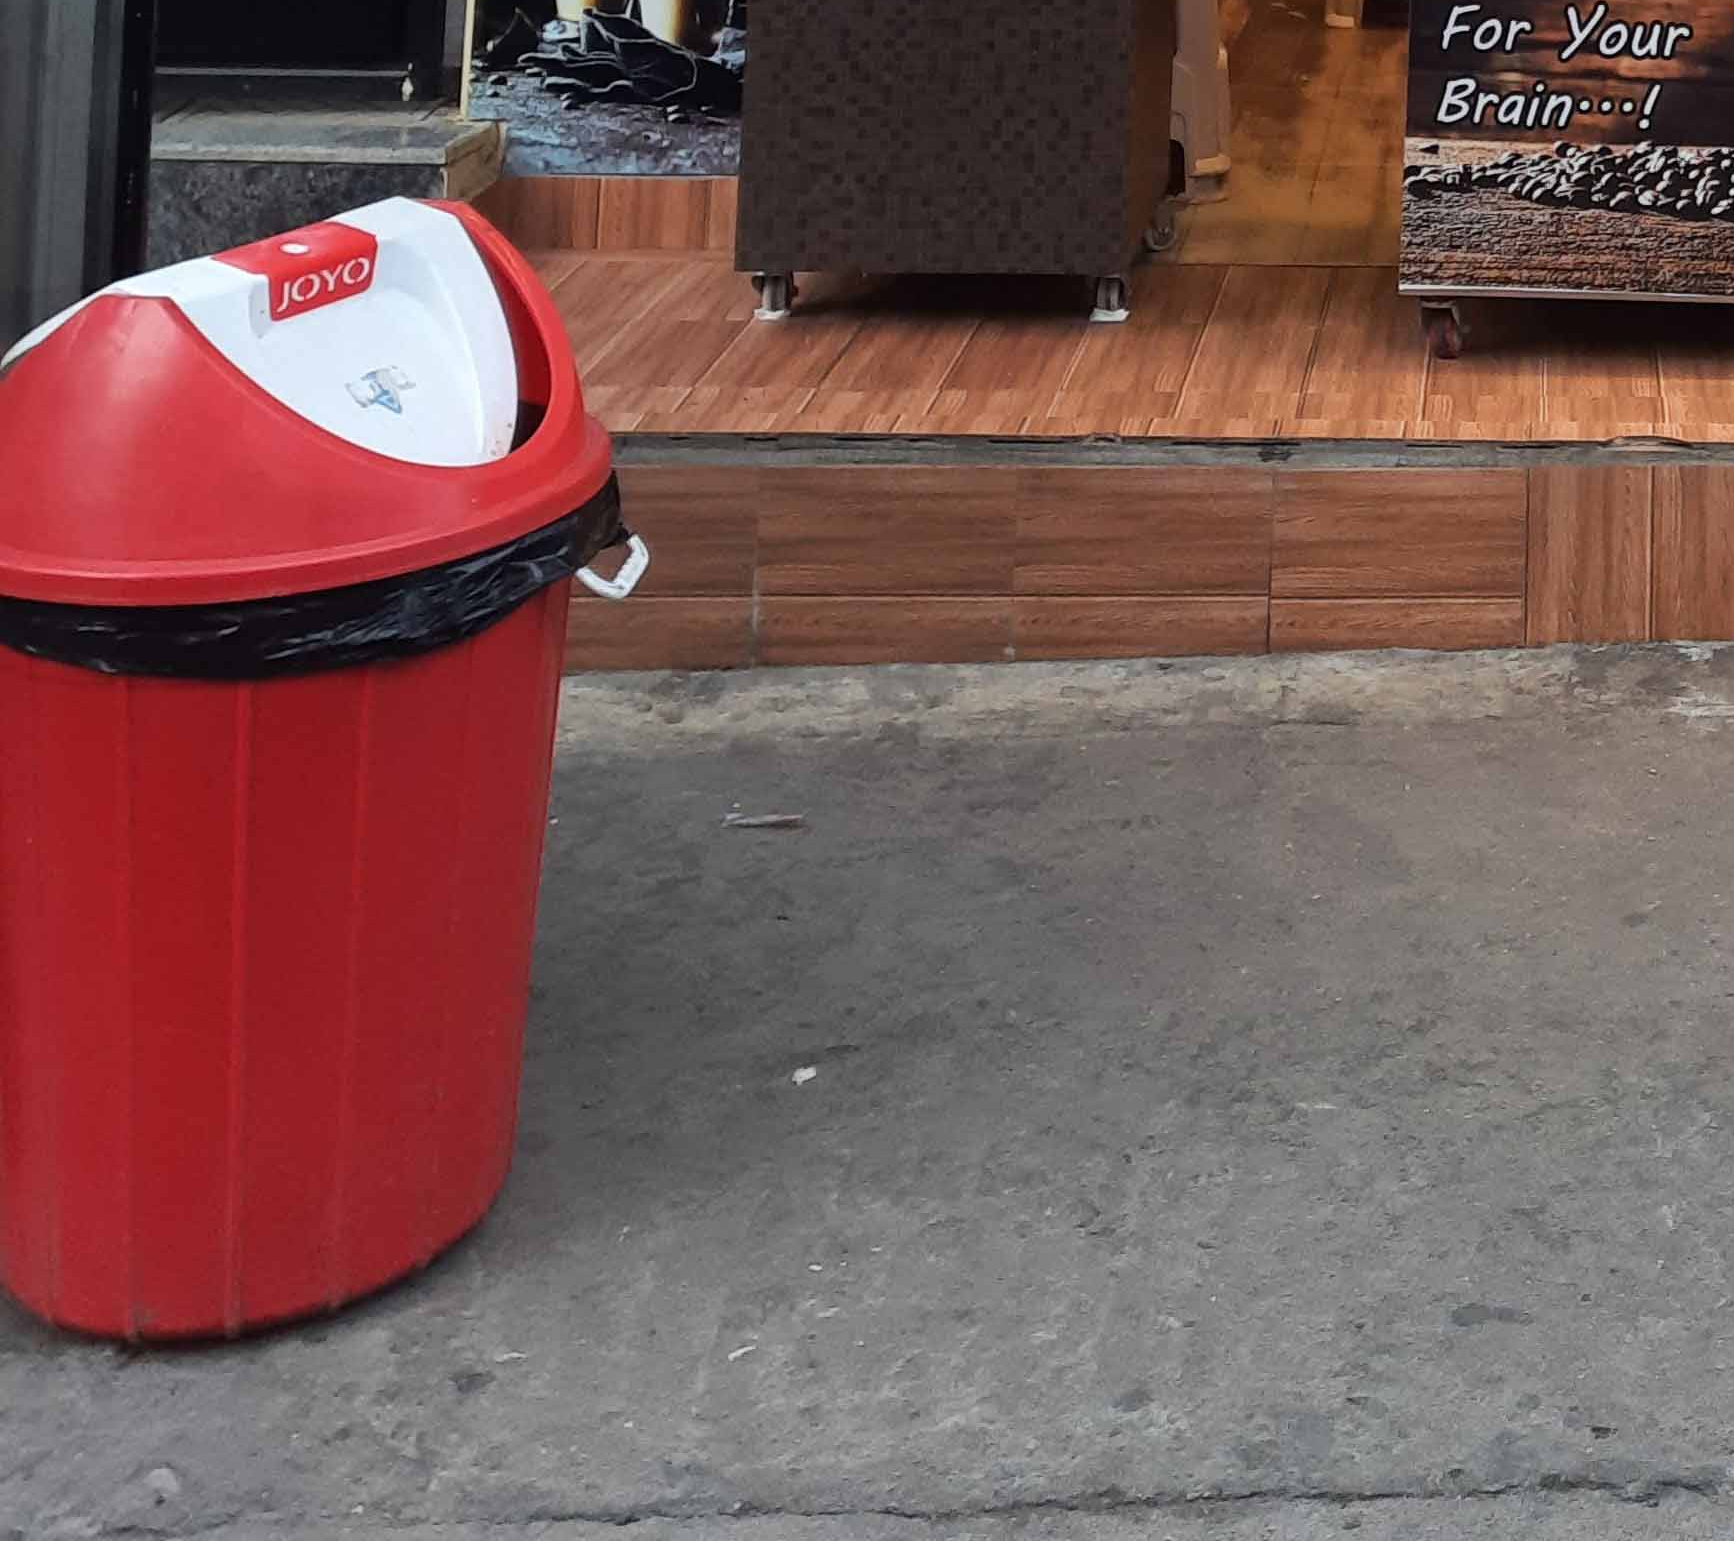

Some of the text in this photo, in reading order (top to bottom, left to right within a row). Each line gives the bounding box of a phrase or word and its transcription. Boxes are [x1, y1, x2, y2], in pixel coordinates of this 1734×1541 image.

[1440, 4, 1693, 61] For Your
[276, 257, 371, 313] JOYO
